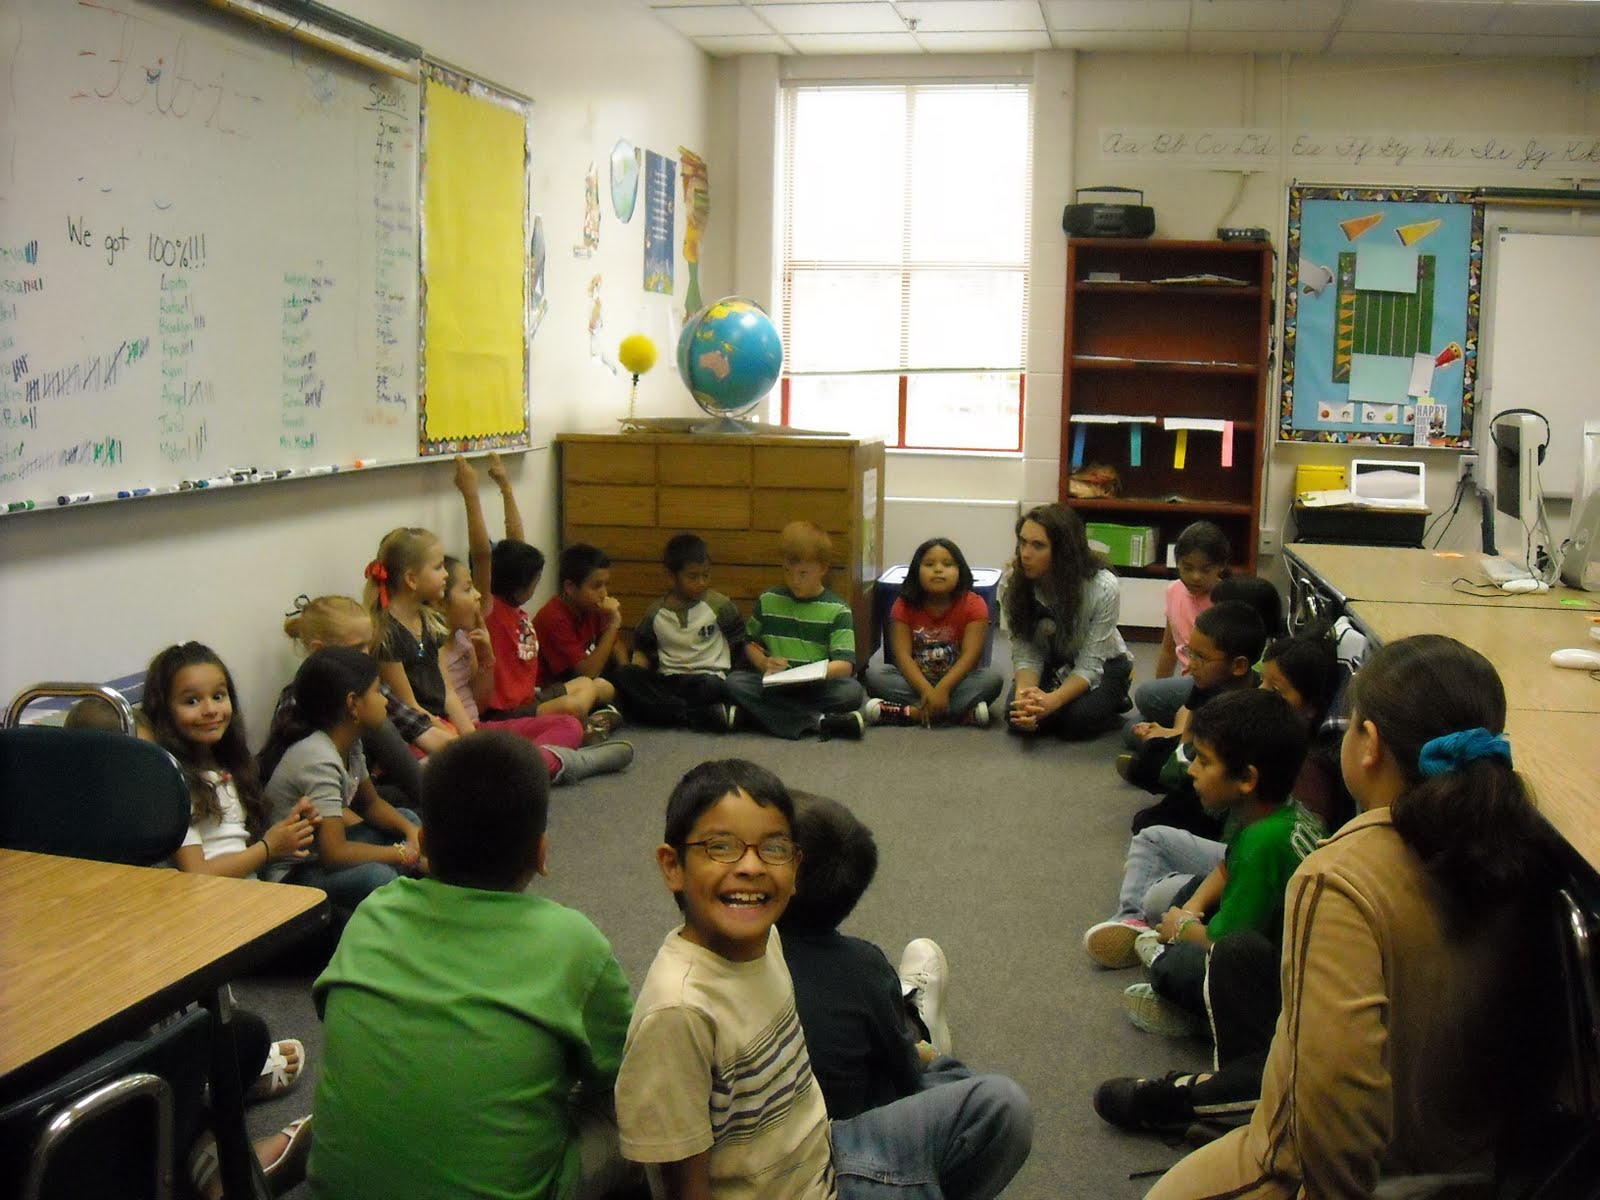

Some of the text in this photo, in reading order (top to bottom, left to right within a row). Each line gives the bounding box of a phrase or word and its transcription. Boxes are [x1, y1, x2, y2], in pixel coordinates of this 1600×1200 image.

[1152, 132, 1188, 154] Bb
[1195, 134, 1232, 154] Cc
[67, 214, 207, 270] We got 100%!!!
[1416, 405, 1446, 417] HAPPY
